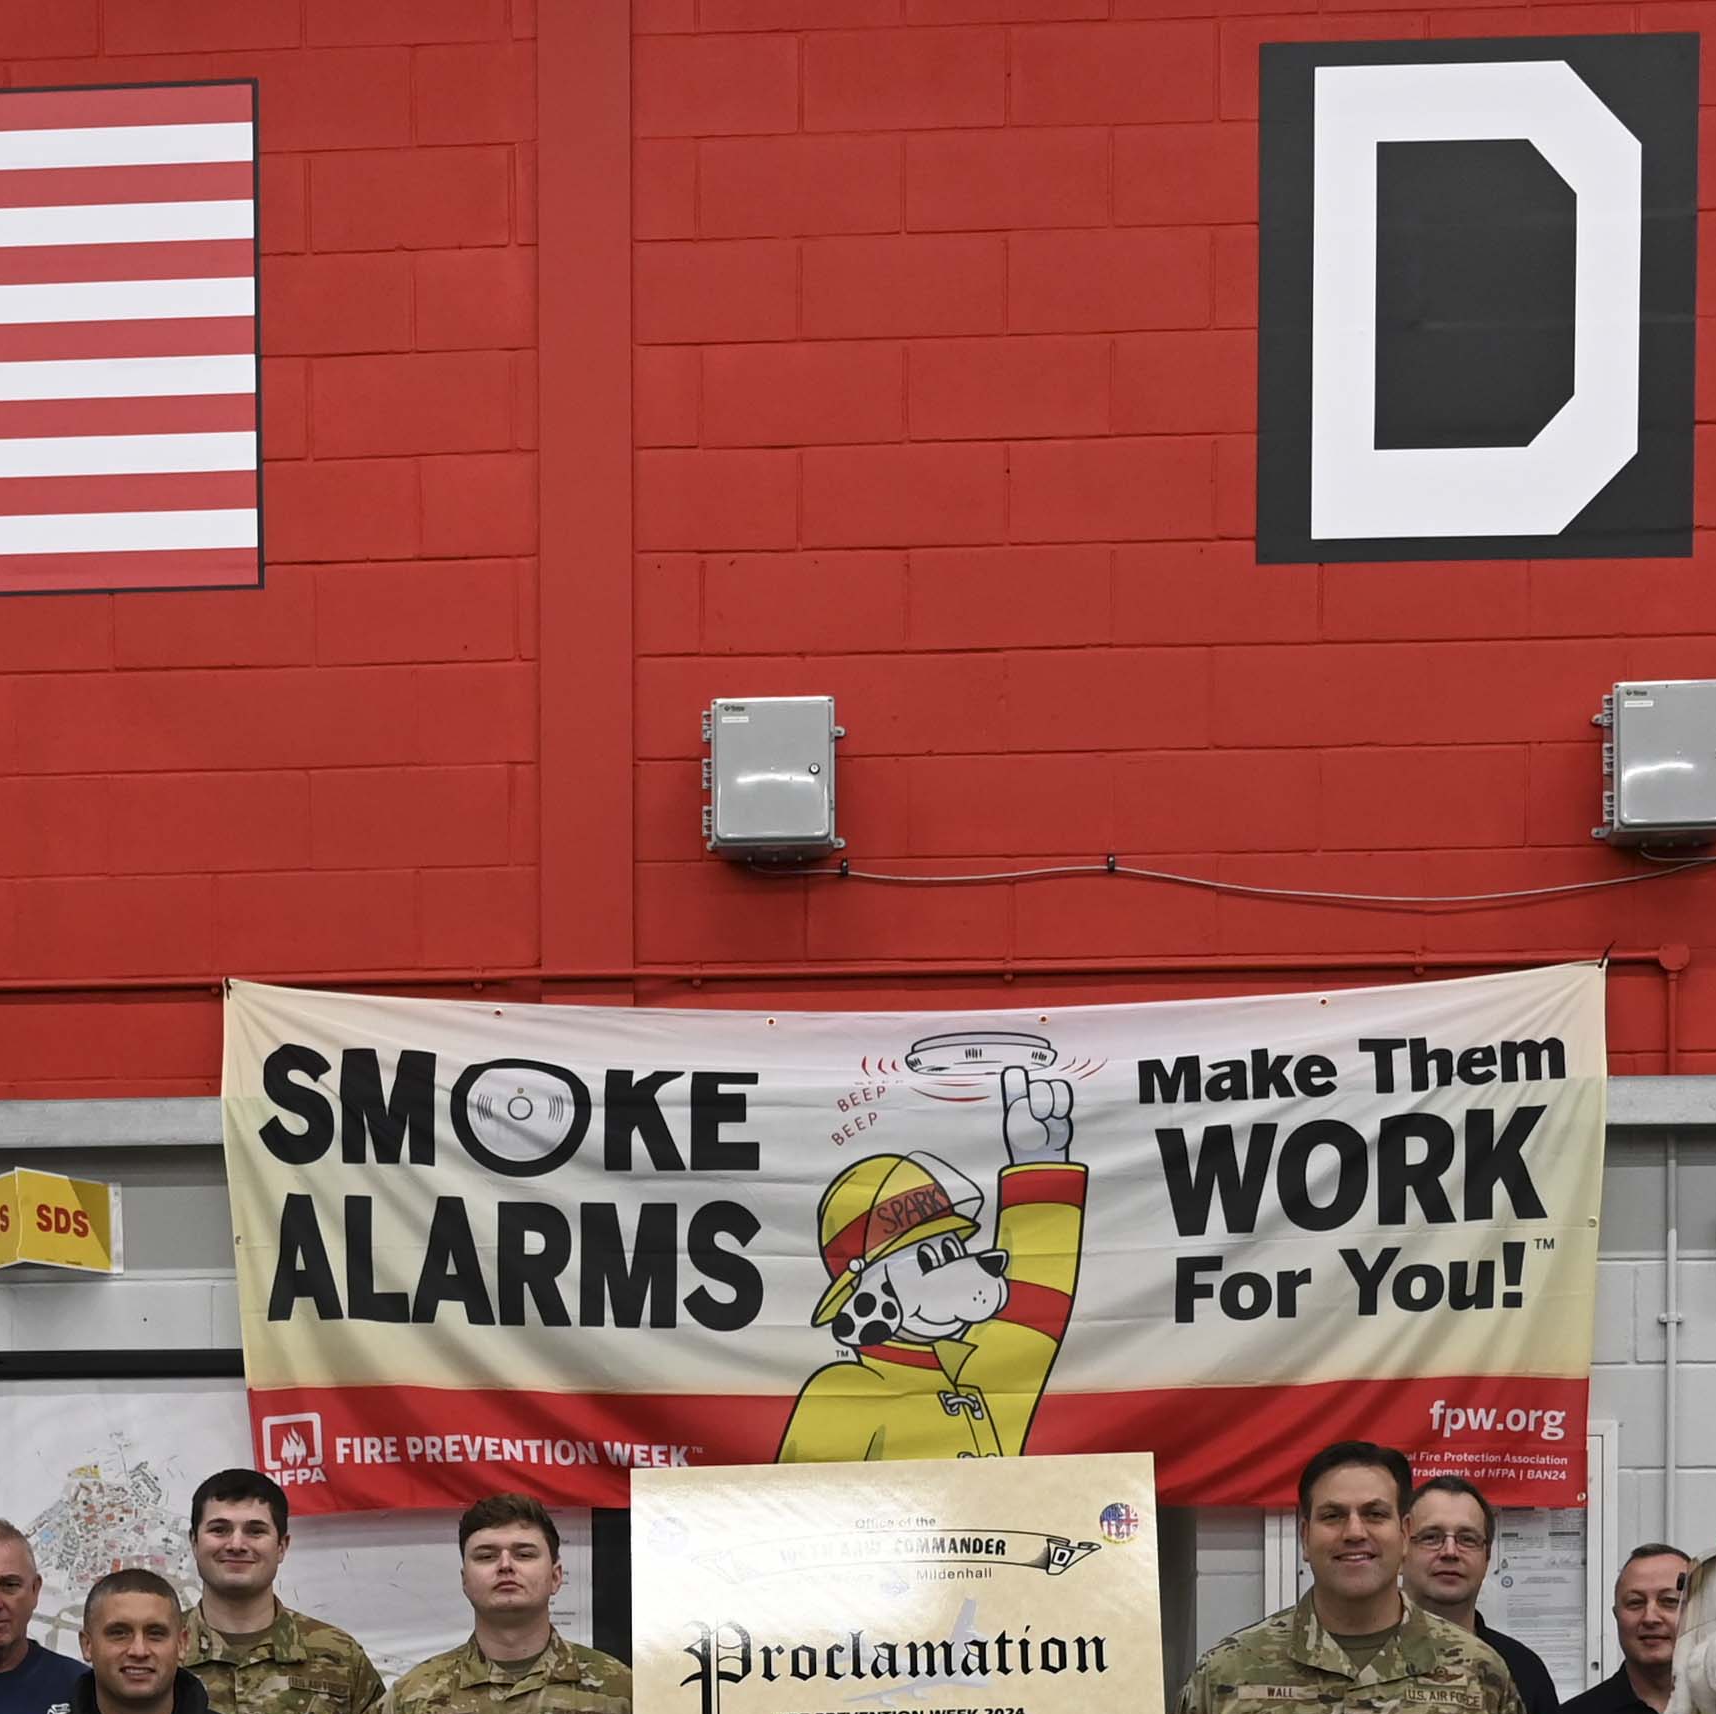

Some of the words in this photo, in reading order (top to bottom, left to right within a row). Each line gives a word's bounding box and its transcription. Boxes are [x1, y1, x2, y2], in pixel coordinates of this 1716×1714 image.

[1311, 60, 1642, 540] D
[1138, 1048, 1338, 1104] Make
[1358, 1036, 1566, 1094] Them
[259, 1043, 760, 1177] SMOKE
[837, 1085, 886, 1112] BEEP
[832, 1112, 878, 1146] BEEP
[1155, 1104, 1548, 1237] WORK
[36, 1203, 90, 1238] SDS
[268, 1192, 763, 1331] ALARMS
[1175, 1255, 1312, 1324] For
[1339, 1241, 1526, 1316] You!
[1429, 1400, 1565, 1440] fpw.org
[335, 1436, 401, 1464] FIRE
[407, 1435, 599, 1466] PREVENTION
[603, 1442, 690, 1468] WEEK
[1420, 1452, 1441, 1462] Fire
[1444, 1452, 1501, 1463] Protection
[1504, 1454, 1568, 1465] Association
[1474, 1468, 1485, 1477] of
[1487, 1470, 1516, 1479] NFPA
[1527, 1469, 1567, 1481] BAN24
[916, 1516, 936, 1527] the
[894, 1537, 1006, 1557] COMMANDER
[916, 1568, 992, 1581] Mildenhall
[680, 1620, 1109, 1687] Proclamation
[1267, 1687, 1294, 1697] WALL
[1430, 1690, 1448, 1701] AIR
